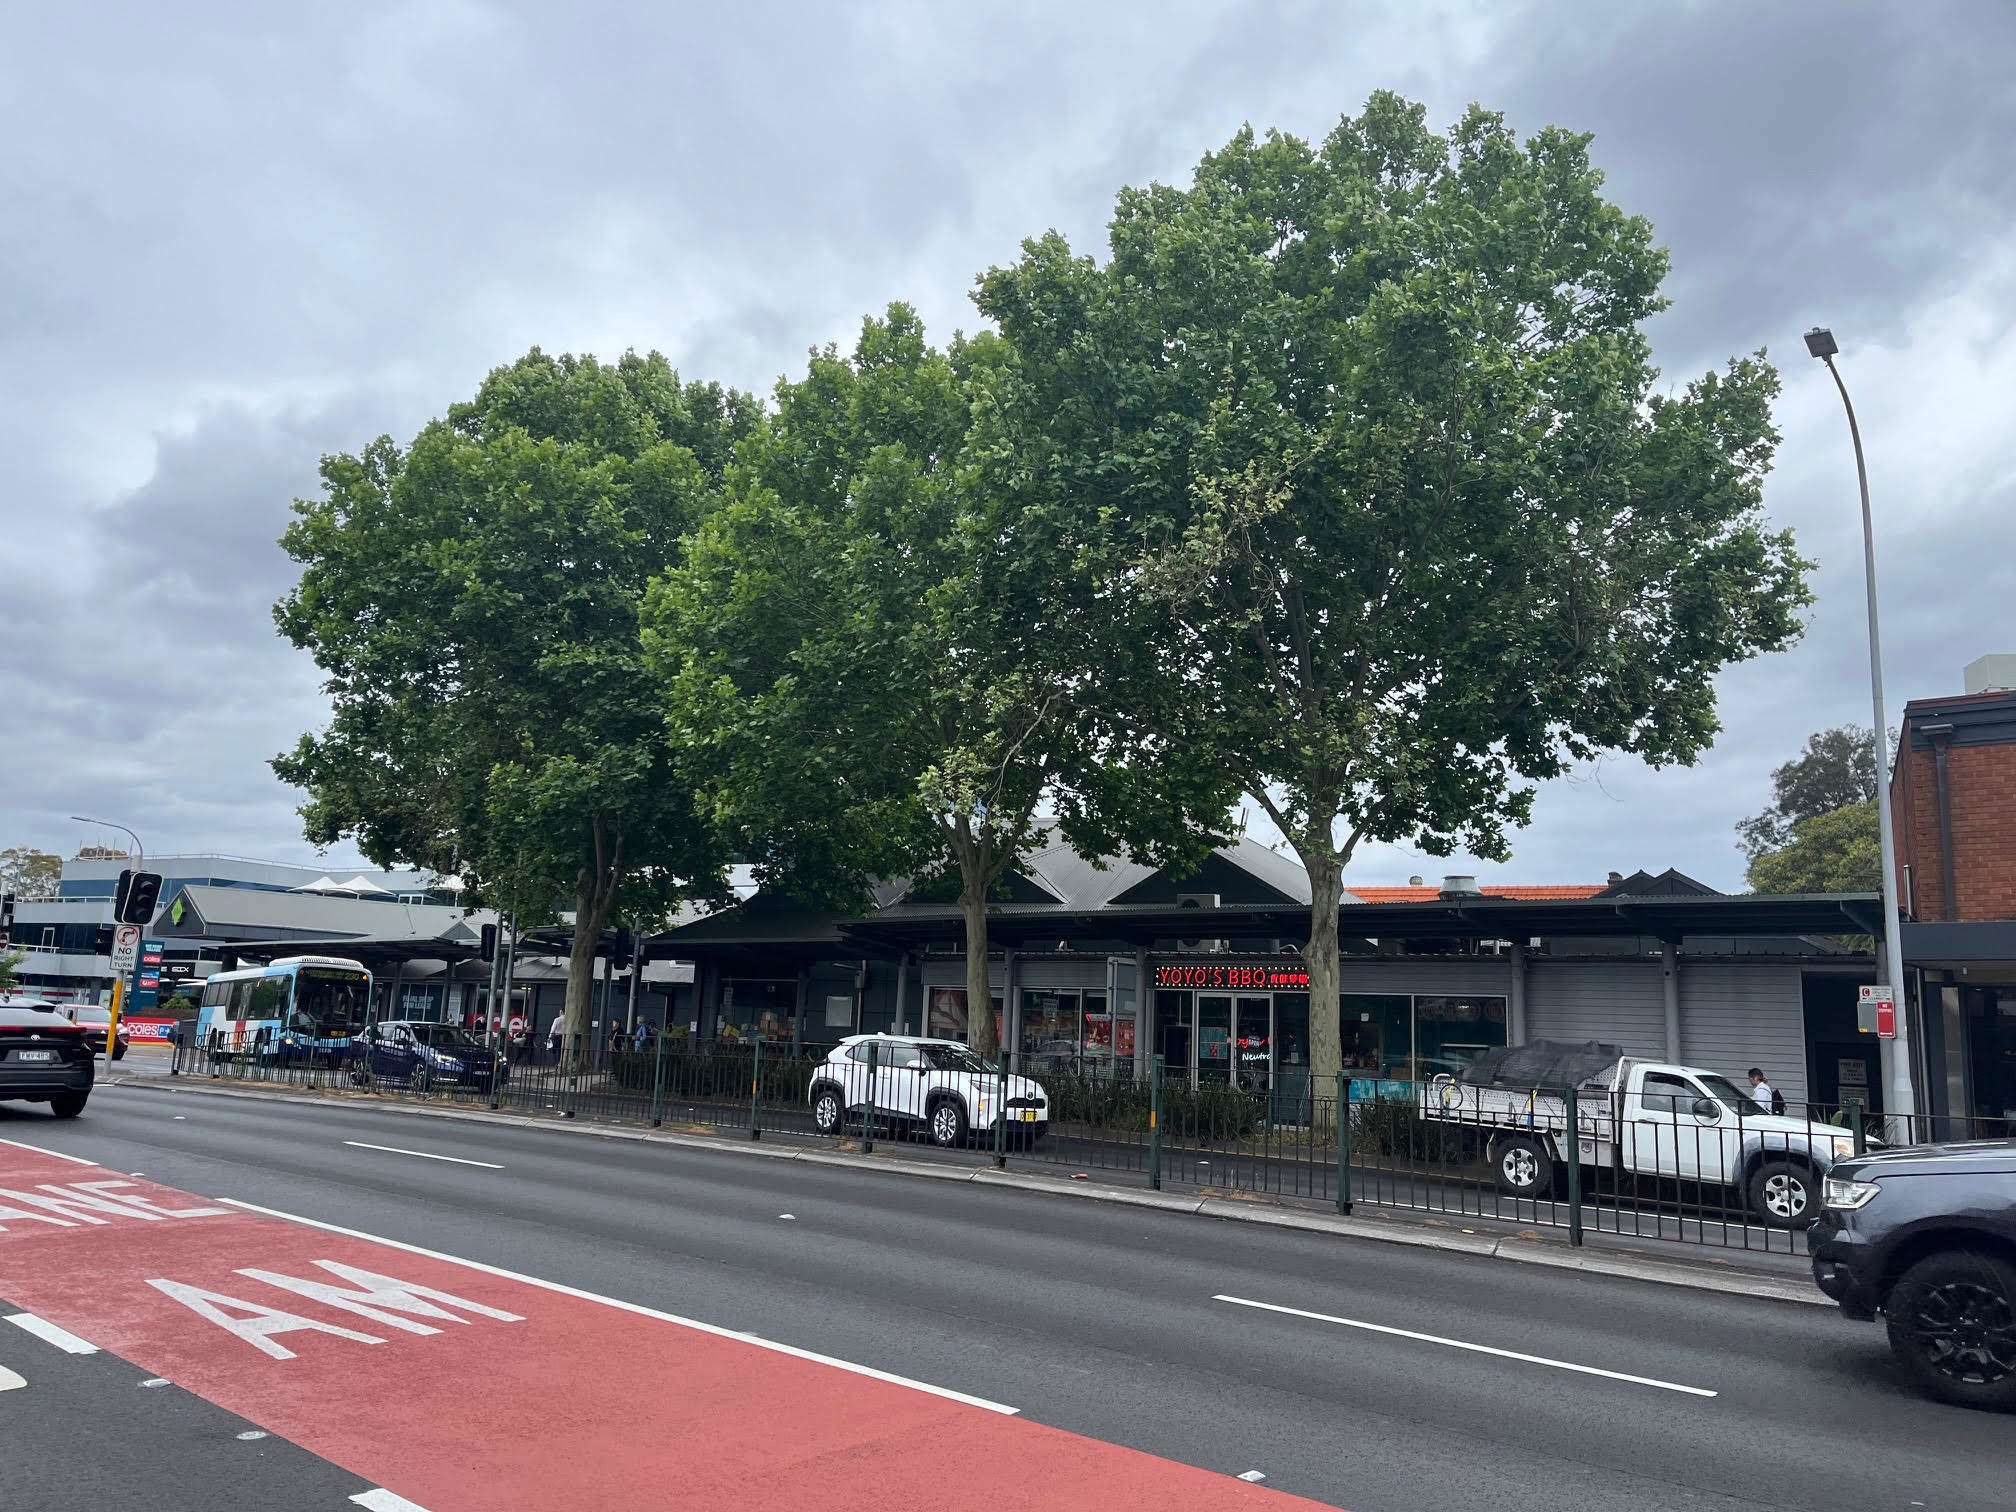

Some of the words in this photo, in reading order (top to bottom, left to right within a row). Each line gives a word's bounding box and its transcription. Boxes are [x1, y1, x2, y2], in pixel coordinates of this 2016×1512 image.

[118, 947, 132, 955] NO
[1160, 969, 1223, 984] YOYO'S
[1229, 969, 1265, 986] BBQ
[128, 1024, 158, 1035] coles
[144, 1259, 527, 1360] AM
